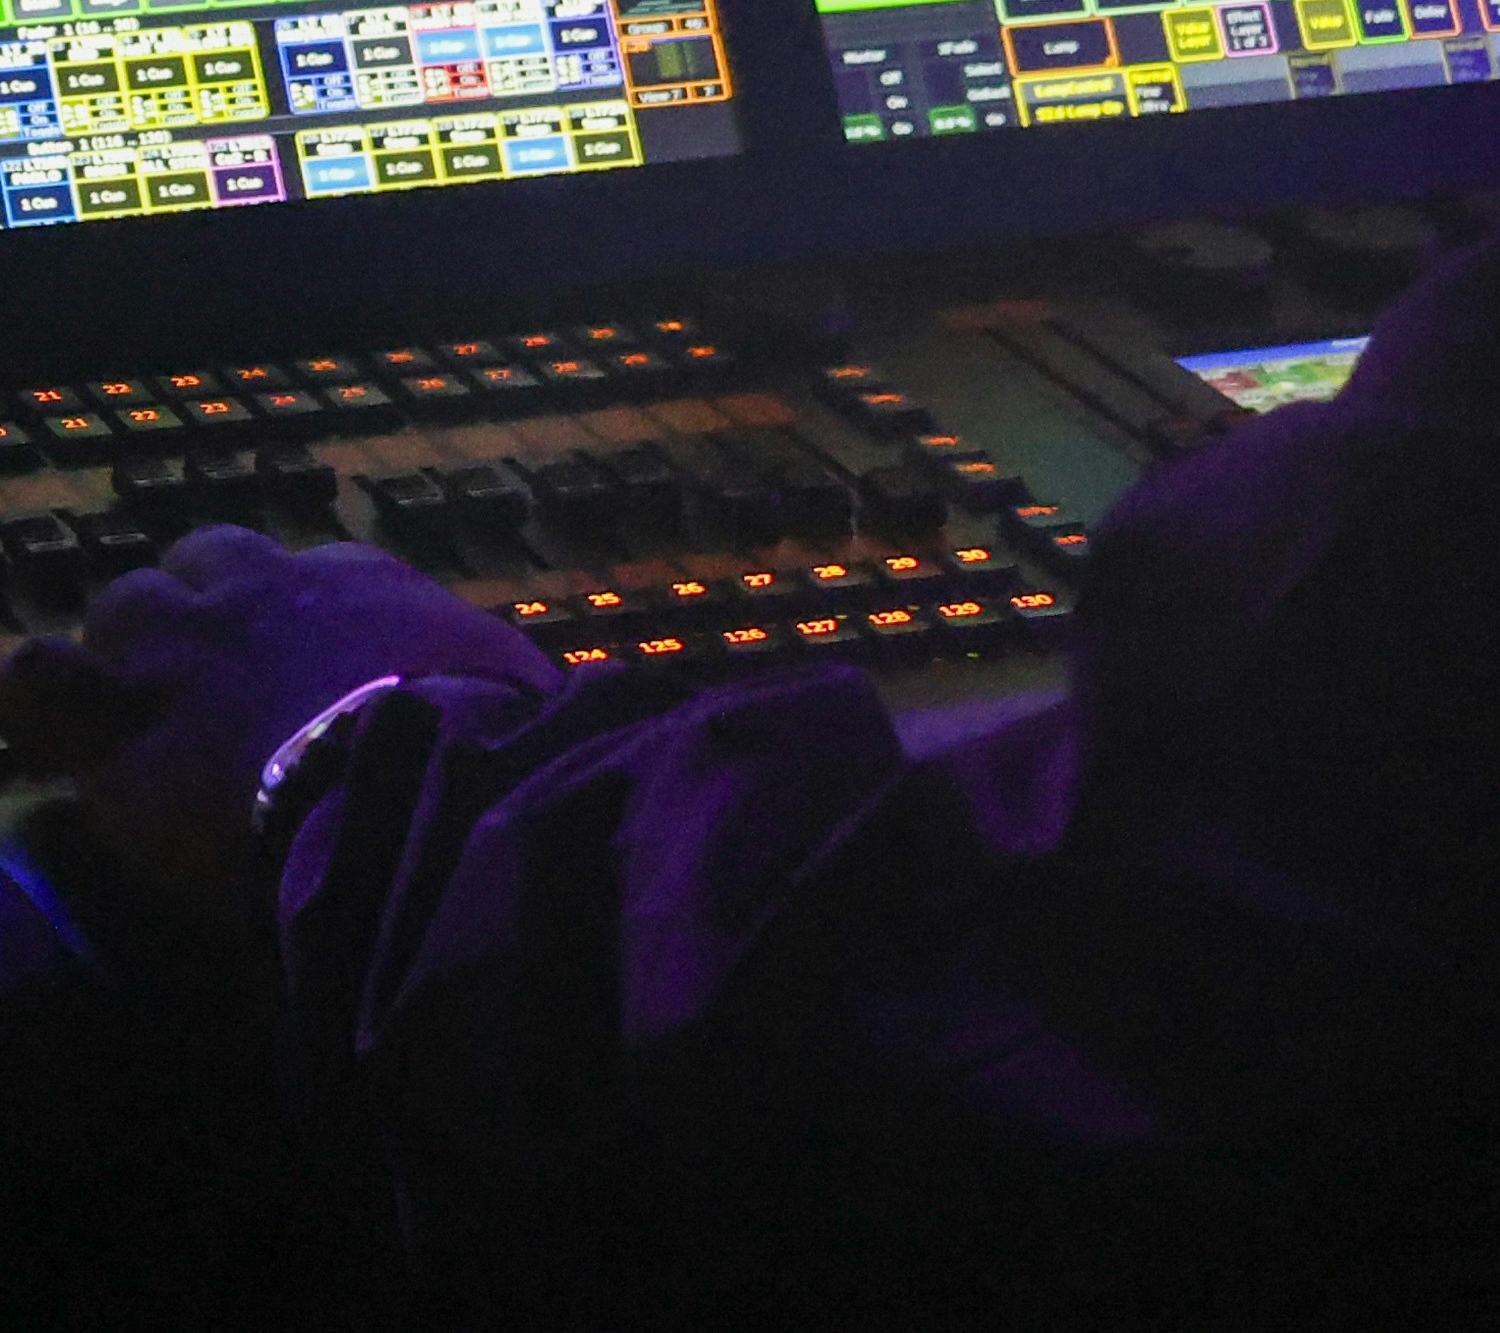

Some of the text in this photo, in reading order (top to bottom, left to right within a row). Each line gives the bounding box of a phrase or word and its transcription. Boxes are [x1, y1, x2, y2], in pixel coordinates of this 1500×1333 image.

[514, 548, 991, 617] 24 25 26 27 28 29 30
[639, 638, 684, 655] 125
[724, 628, 769, 645] 126
[796, 617, 838, 636] 127
[868, 609, 911, 628] 128
[938, 601, 983, 619] 129
[1011, 593, 1054, 609] 130
